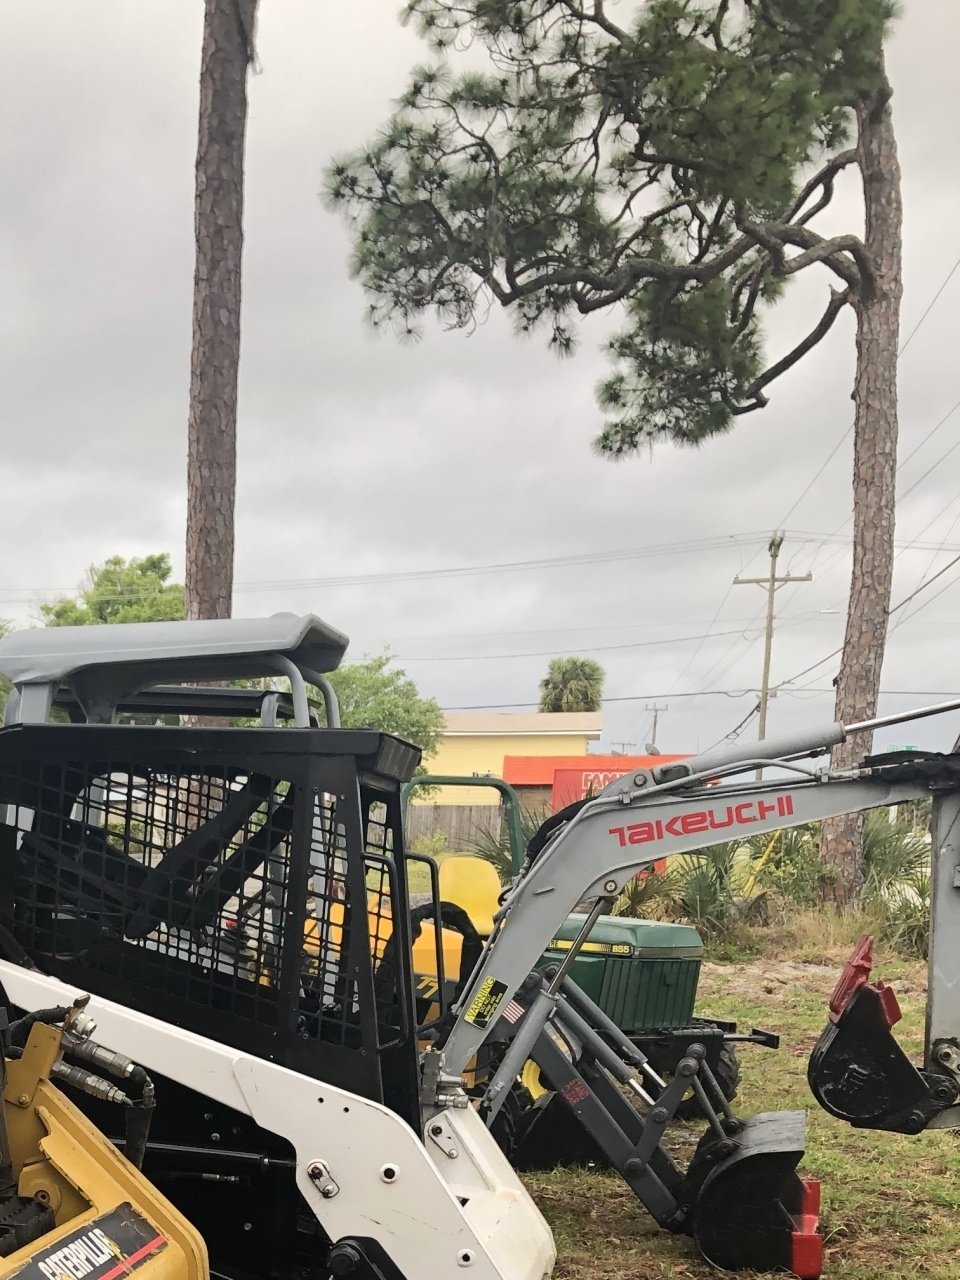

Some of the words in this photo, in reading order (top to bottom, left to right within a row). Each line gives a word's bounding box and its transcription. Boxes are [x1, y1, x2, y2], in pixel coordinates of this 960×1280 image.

[581, 771, 629, 790] FAM
[609, 794, 794, 847] TAKEUCHI
[612, 944, 630, 954] 855
[467, 976, 495, 1020] WARNING
